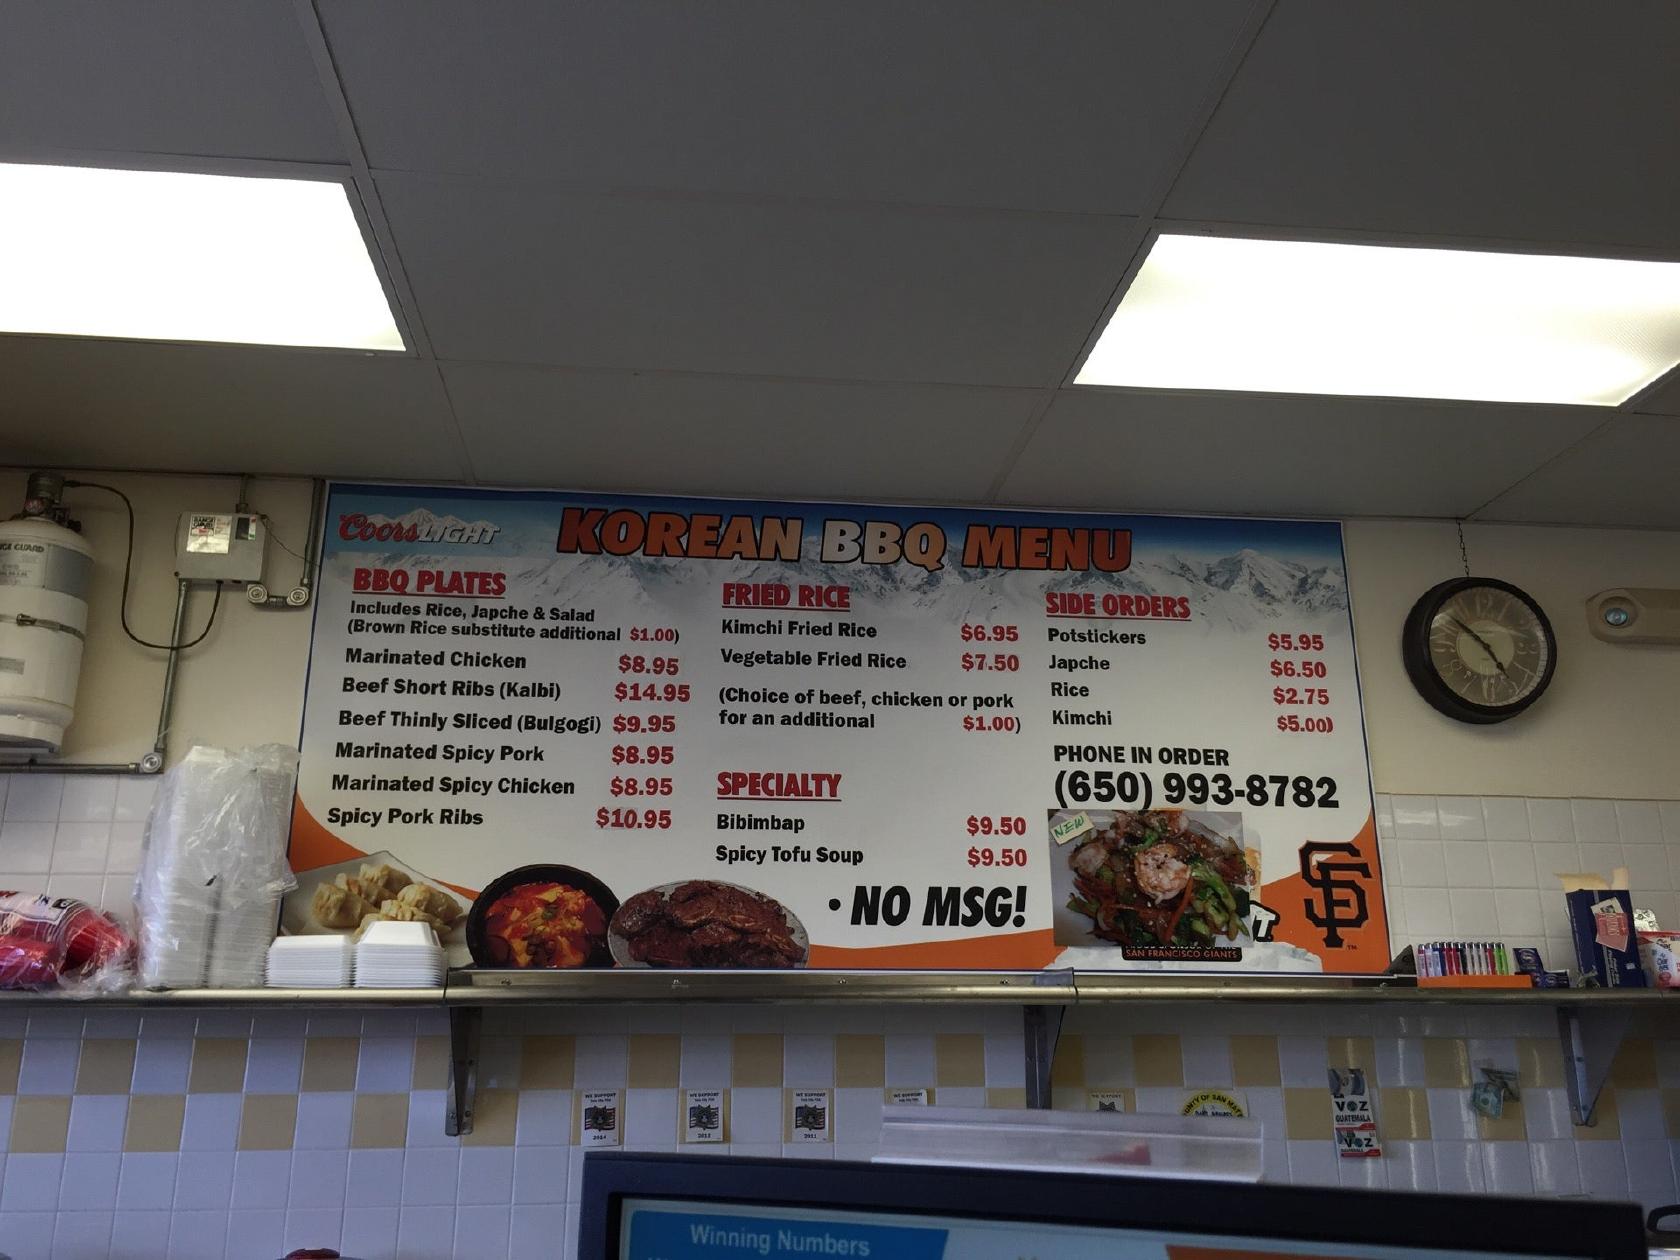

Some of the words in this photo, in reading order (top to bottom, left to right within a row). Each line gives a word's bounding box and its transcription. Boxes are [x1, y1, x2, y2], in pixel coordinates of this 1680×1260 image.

[339, 513, 420, 542] Coors
[417, 525, 501, 545] LIGHT
[556, 507, 803, 561] KOREAN
[820, 518, 948, 572] BBQ
[961, 524, 1132, 573] MENU
[353, 568, 408, 594] BBQ
[416, 570, 506, 597] PLATES
[722, 583, 791, 607] FRIED
[798, 585, 850, 608] RICE
[1046, 592, 1095, 615] SIDE
[1102, 594, 1191, 619] ORDERS
[350, 601, 421, 617] Includes
[426, 603, 467, 620] Rice,
[471, 605, 529, 623] Japche
[533, 608, 545, 620] &
[549, 608, 595, 622] Salad
[347, 619, 405, 635] (Brown
[410, 620, 447, 636] Rice
[451, 622, 536, 639] substitute
[540, 625, 621, 642] additional
[630, 627, 680, 644] $1.00)
[722, 619, 783, 635] Kimchi
[788, 620, 833, 636] Fried
[838, 623, 877, 638] Rice
[961, 623, 1019, 642] $6.95
[1048, 628, 1146, 645] Potstickers
[1268, 632, 1324, 652] $5.95
[345, 648, 445, 667] Marinated
[450, 651, 527, 669] Chicken
[619, 655, 679, 676] $8.95
[721, 649, 812, 667] Vegetable
[817, 651, 862, 667] Fried
[868, 653, 907, 668] Rice
[961, 652, 1019, 672] $7.50
[1049, 655, 1110, 673] Japche
[1270, 660, 1326, 679] $6.50
[342, 677, 389, 694] Beef
[394, 679, 446, 696] Short
[452, 680, 494, 697] Ribs
[499, 681, 561, 701] (Kalbi)
[614, 682, 691, 702] $14.95
[719, 687, 789, 705] (Choice
[795, 689, 815, 704] of
[819, 689, 866, 708] beef,
[871, 691, 943, 707] chicken
[948, 695, 967, 708] or
[973, 693, 1014, 710] pork
[1051, 682, 1089, 697] Rice
[1273, 686, 1329, 706] $2.75
[338, 710, 386, 726] Beef
[390, 711, 448, 731] Thinly
[452, 713, 512, 731] Sliced
[517, 715, 602, 734] (Bulgogi)
[613, 714, 676, 735] $9.95
[719, 709, 747, 725] for
[752, 713, 775, 726] an
[780, 712, 875, 728] additional
[963, 715, 1021, 734] $1.00)
[1052, 710, 1112, 726] Kimchi
[1277, 714, 1333, 734] $5.00)
[335, 742, 437, 760] Marinated
[442, 744, 494, 764] Spicy
[500, 745, 545, 762] Pork
[612, 744, 675, 765] $8.95
[1054, 745, 1124, 763] PHONE
[1131, 746, 1152, 764] IN
[1159, 747, 1229, 766] ORDER
[331, 774, 434, 792] Marinated
[439, 776, 493, 796] Spicy
[497, 777, 575, 794] Chicken
[610, 776, 673, 797] $8.95
[717, 771, 842, 797] SPECIALTY
[1055, 770, 1152, 809] (650)
[1163, 774, 1339, 808] 993-8782
[327, 807, 382, 827] Spicy
[387, 808, 433, 825] Pork
[439, 808, 484, 825] Ribs
[596, 806, 672, 829] $10.95
[716, 814, 805, 833] Bibimbap
[966, 815, 1026, 836] $9.50
[1054, 815, 1084, 838] NEW
[716, 845, 766, 865] Spicy
[771, 846, 811, 862] Tofu
[816, 847, 863, 866] Soup
[967, 846, 1027, 868] $9.50
[850, 885, 911, 927] NO
[922, 886, 1027, 928] MSG!
[1126, 949, 1145, 957] SAN
[1148, 950, 1201, 958] FRANCISCO
[1203, 950, 1237, 958] GIANTS
[1212, 1094, 1227, 1102] SAN
[690, 1224, 770, 1255] Winning
[777, 1230, 870, 1256] Numbers
